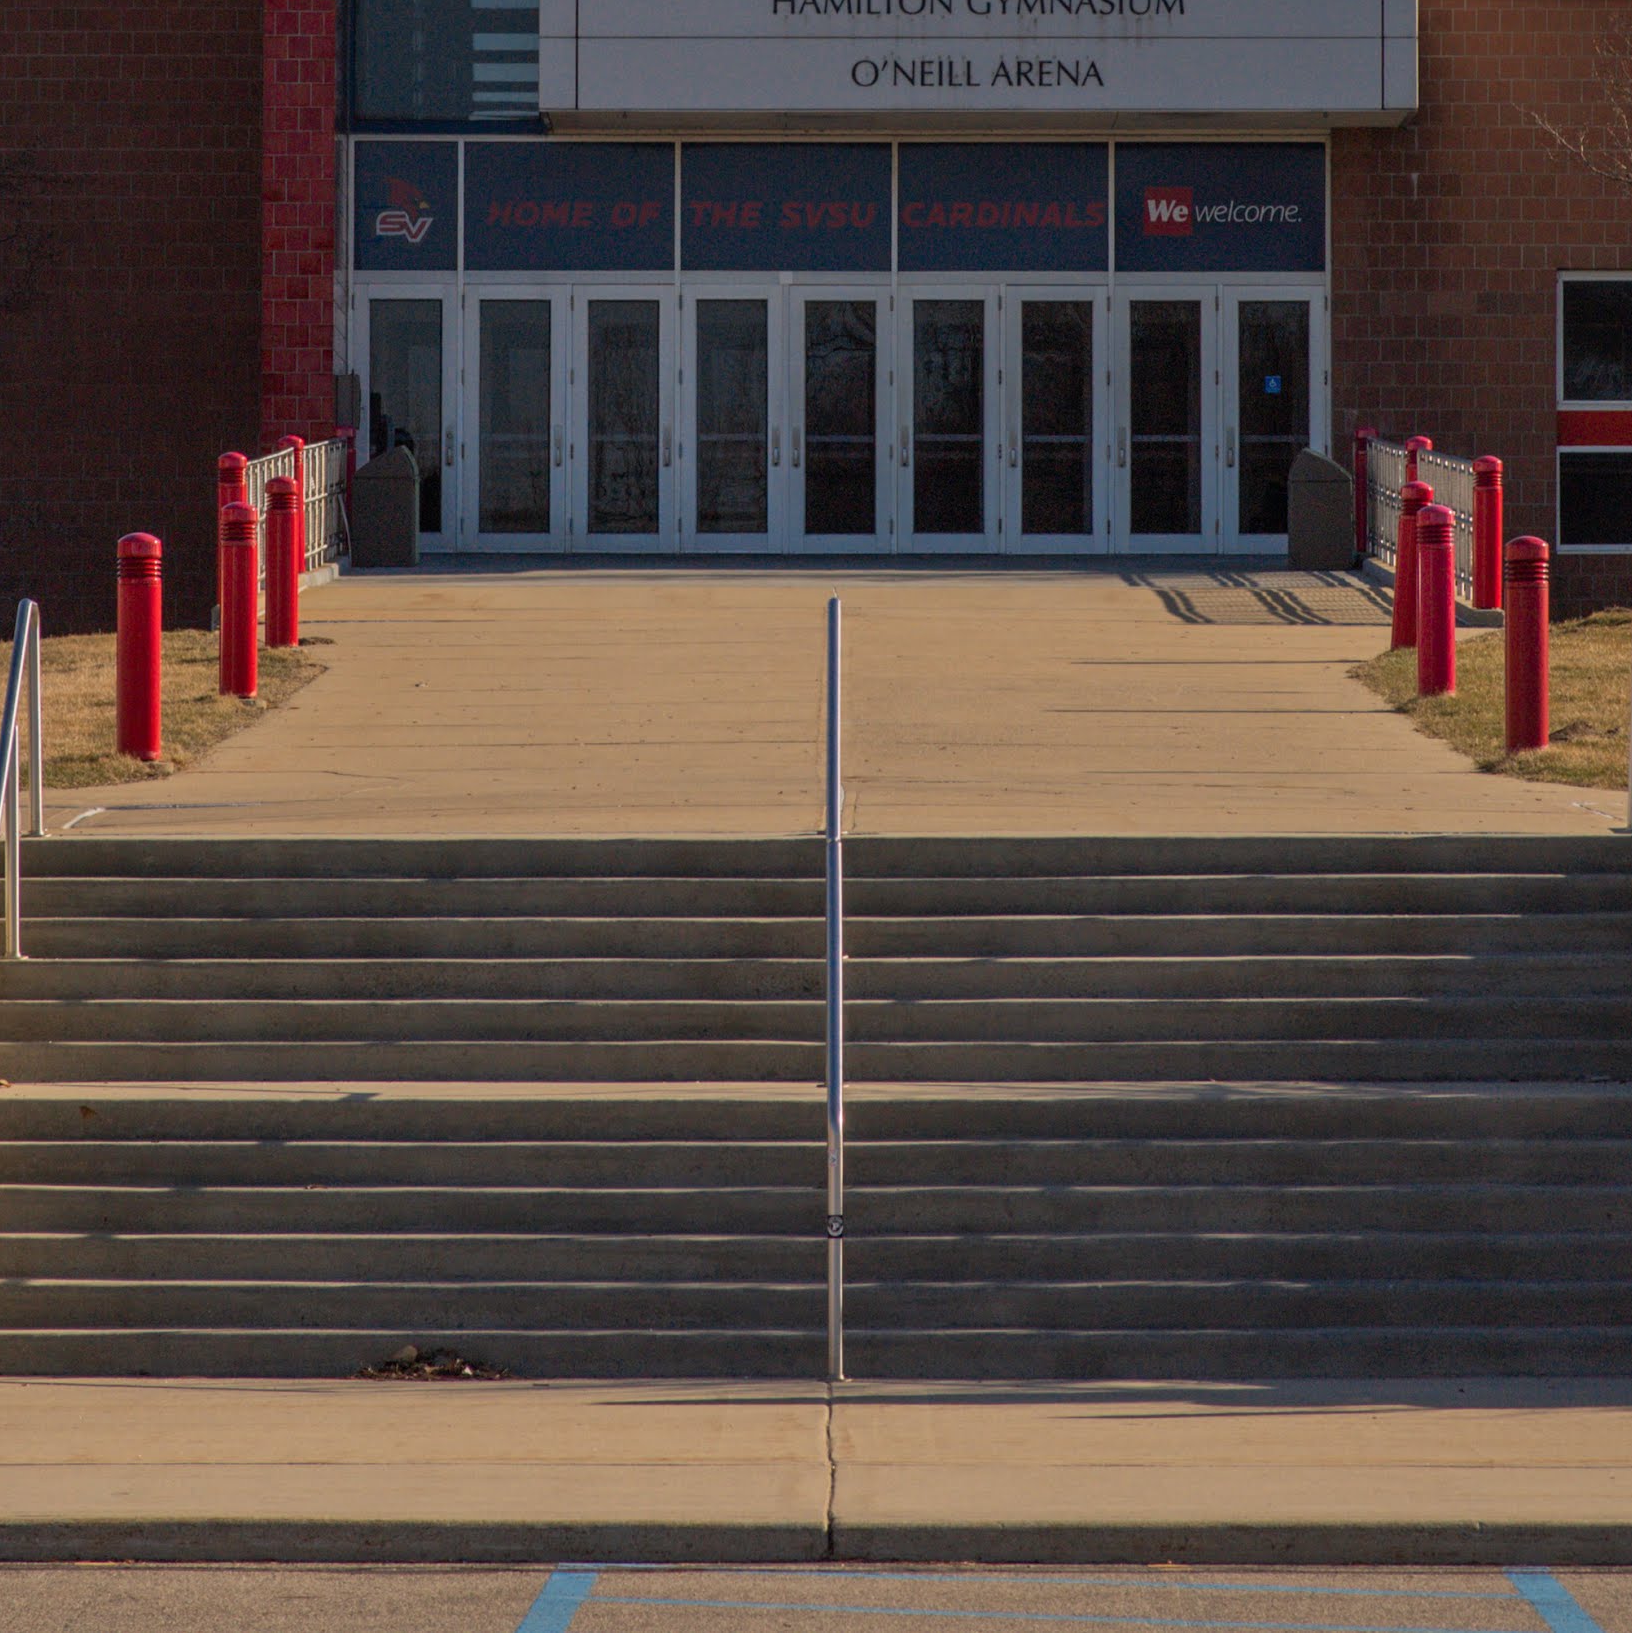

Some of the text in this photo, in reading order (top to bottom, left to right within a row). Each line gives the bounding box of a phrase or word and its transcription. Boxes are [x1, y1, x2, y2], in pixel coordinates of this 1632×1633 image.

[850, 59, 1104, 88] O'NEILL ARENA
[485, 201, 1106, 228] HOME OF THE SVSU CARDINALS
[1146, 198, 1303, 224] We welcome.
